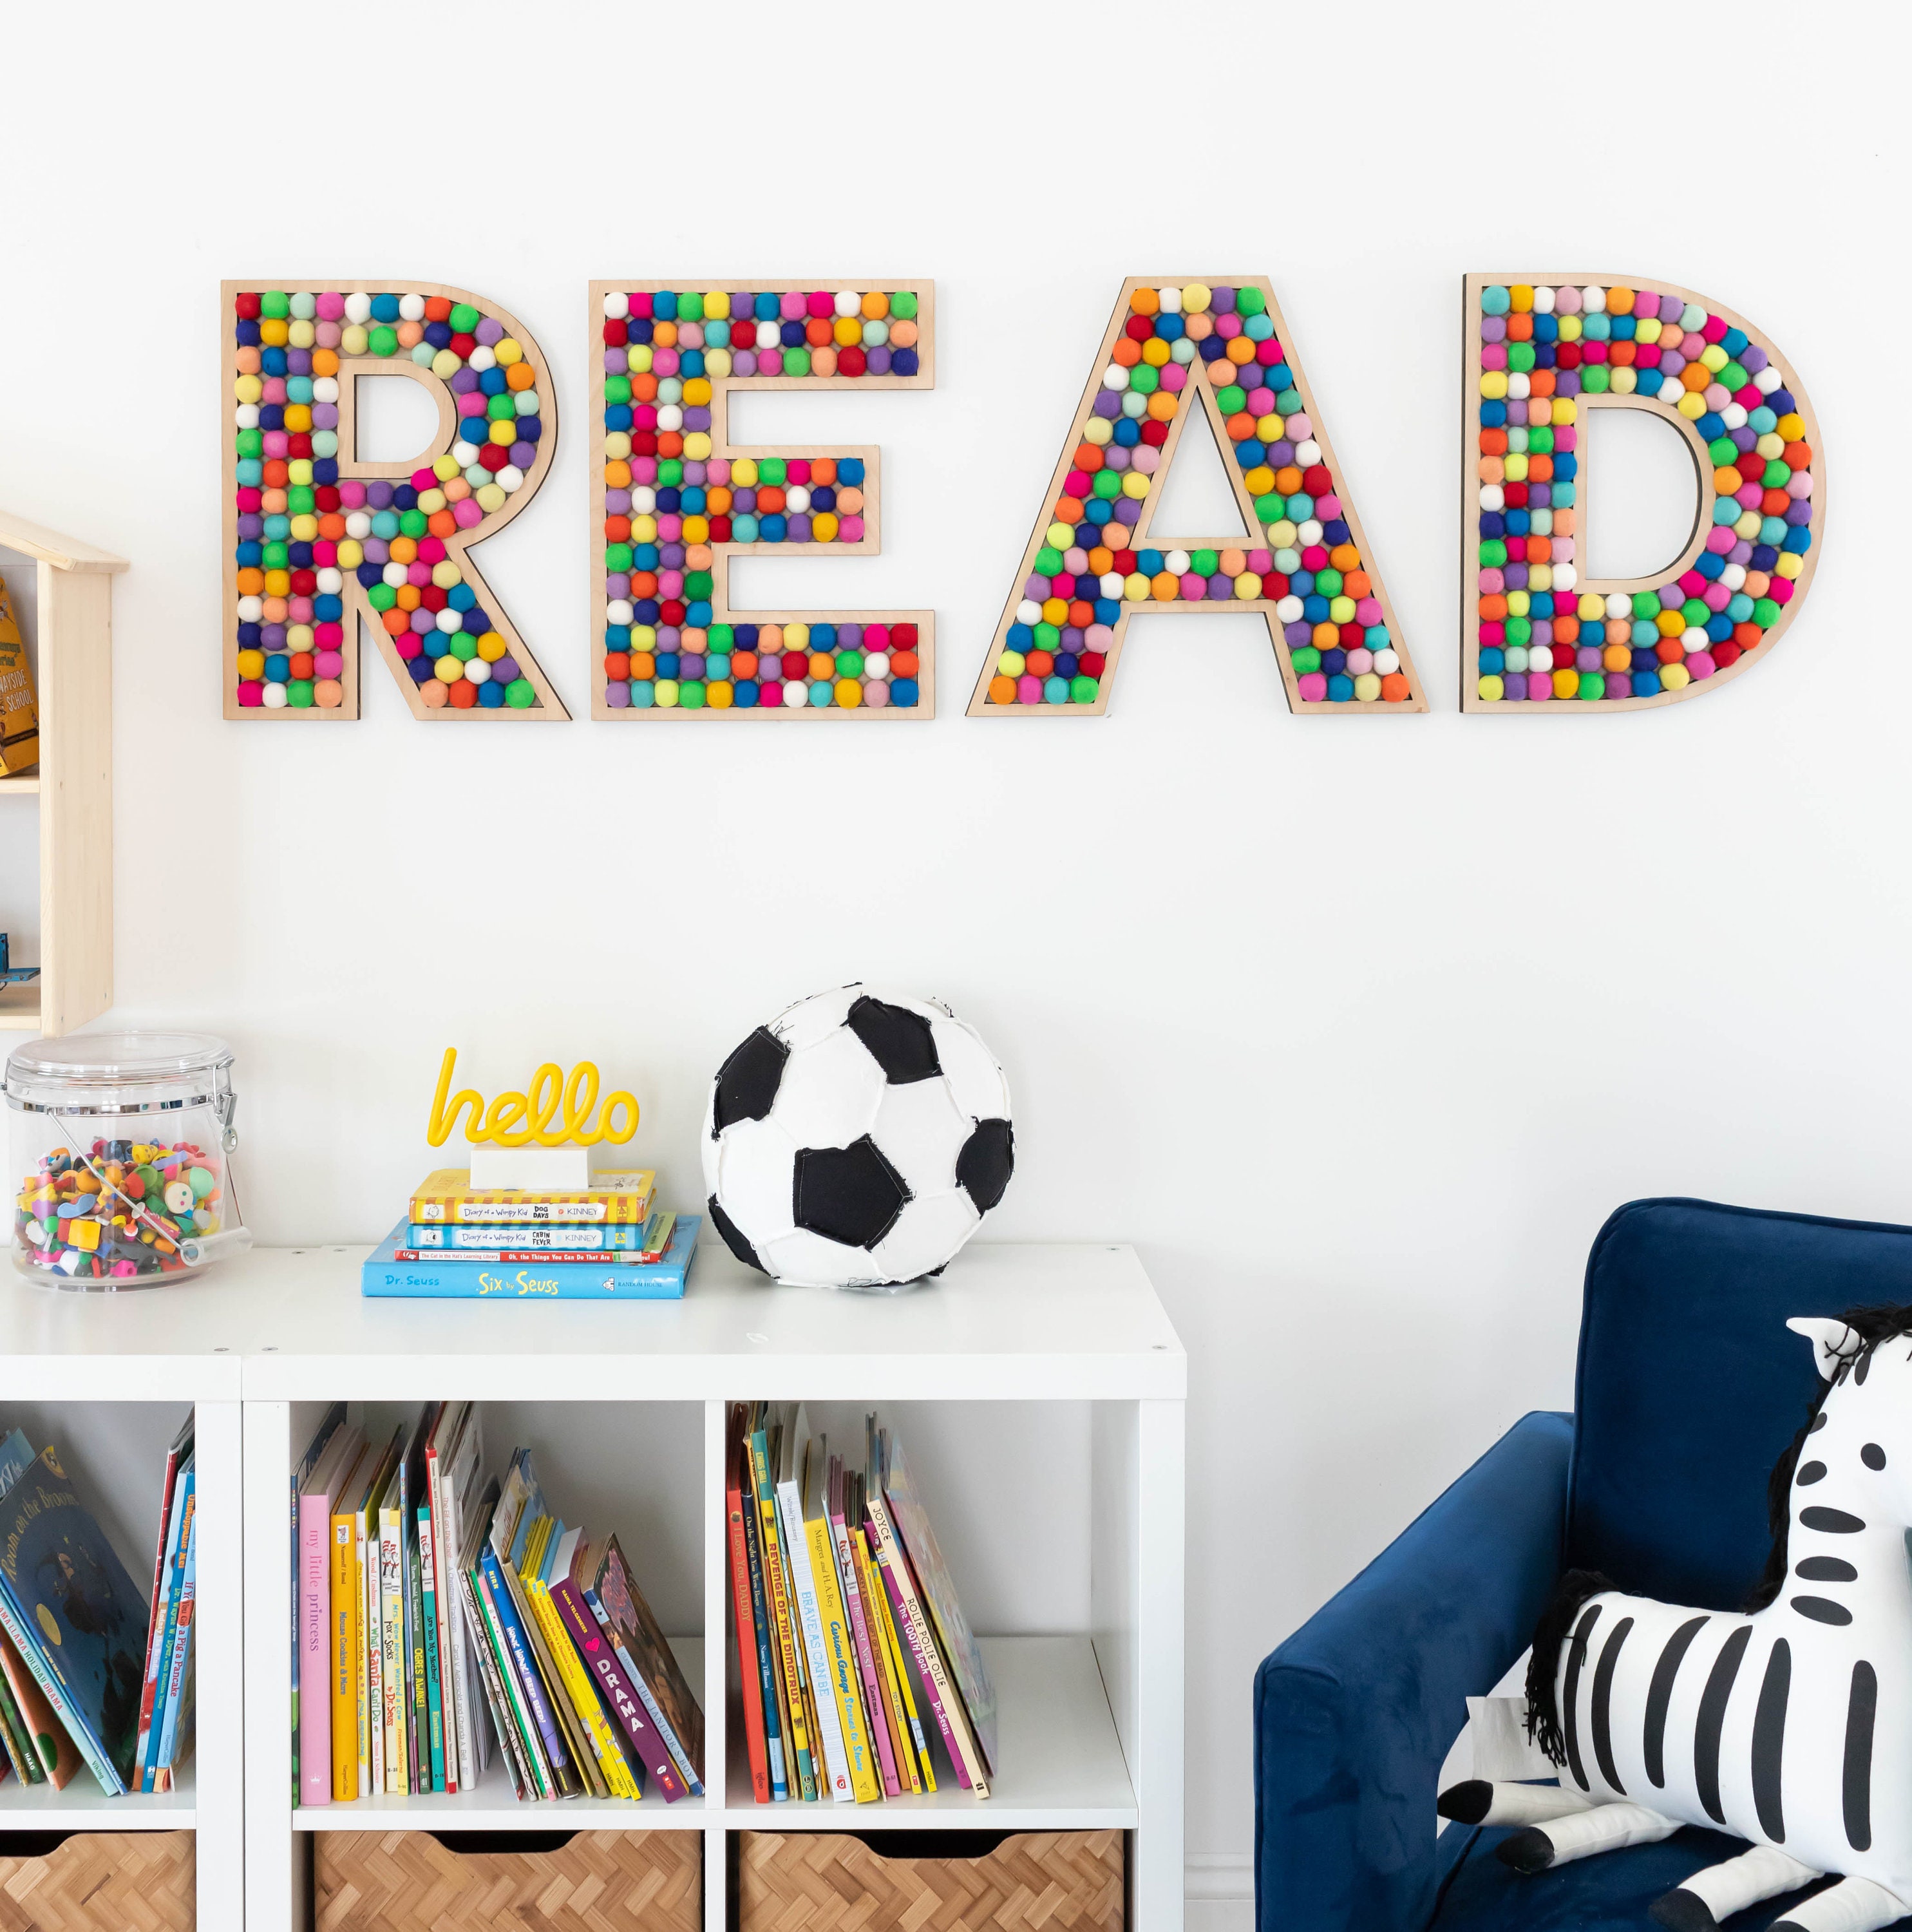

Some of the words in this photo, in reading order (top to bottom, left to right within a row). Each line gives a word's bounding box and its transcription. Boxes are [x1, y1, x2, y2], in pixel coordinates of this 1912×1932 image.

[221, 273, 1826, 721] READ
[6, 689, 33, 712] SCHOOL
[428, 1047, 639, 1147] hello
[464, 1208, 483, 1217] Diary
[495, 1208, 516, 1217] Wimpy
[518, 1208, 528, 1216] Kid
[493, 1234, 515, 1243] Wimpy
[385, 1275, 402, 1284] Dr.
[406, 1276, 439, 1285] Seuss
[479, 1273, 502, 1294] Six
[516, 1271, 558, 1295] Seuss
[755, 1452, 766, 1470] CHRIS
[746, 1516, 753, 1527] On
[871, 1506, 893, 1542] JOYCE
[2, 1533, 20, 1582] Room
[23, 1497, 41, 1519] the
[35, 1486, 79, 1509] Broom
[306, 1530, 318, 1548] my
[733, 1533, 745, 1557] Love
[813, 1530, 826, 1559] Margret
[747, 1540, 756, 1558] Night
[309, 1555, 321, 1587] little
[487, 1569, 500, 1589] KIRK
[734, 1559, 747, 1582] You,
[768, 1542, 784, 1597] REVENGE
[560, 1589, 573, 1605] RAINA
[568, 1604, 589, 1634] TELGEMEIER
[737, 1584, 752, 1622] DADDY
[777, 1600, 786, 1616] OF
[800, 1591, 818, 1631] BRAVE
[851, 1600, 862, 1618] The
[896, 1602, 909, 1619] The
[307, 1593, 322, 1651] princess
[384, 1621, 393, 1633] Fox
[779, 1617, 790, 1640] THE
[856, 1566, 866, 1589] MICKEY
[862, 1596, 873, 1623] MINNIE'S
[871, 1639, 878, 1648] OF
[876, 1662, 884, 1678] MAGI
[856, 1620, 867, 1642] Best
[175, 1636, 186, 1652] Pig
[370, 1627, 379, 1648] What
[427, 1642, 436, 1654] My
[808, 1633, 820, 1649] AS
[829, 1620, 846, 1659] Curious
[901, 1619, 922, 1653] TOOTH
[905, 1597, 924, 1628] ROLIE
[918, 1630, 936, 1660] POLIE
[930, 1662, 947, 1687] OLIE
[339, 1637, 347, 1666] Cookies
[384, 1639, 394, 1660] Socks
[413, 1647, 424, 1674] OGRES
[860, 1645, 872, 1669] Nest
[7, 1624, 28, 1652] LLAMA
[23, 1650, 46, 1683] HOLIDAY
[42, 1681, 63, 1712] DRAMA
[370, 1649, 381, 1686] Santa
[428, 1654, 439, 1683] Mother?
[506, 1625, 522, 1649] HONK
[514, 1648, 531, 1676] HONK!
[524, 1676, 538, 1699] BEEP
[531, 1699, 546, 1723] BEEP!
[783, 1643, 799, 1705] DINOTRUX
[811, 1651, 827, 1680] CAN
[914, 1651, 931, 1676] Book
[169, 1660, 182, 1697] Pancake
[393, 1667, 402, 1696] Wanted
[762, 1665, 770, 1689] Tillman
[817, 1681, 830, 1697] BE
[835, 1659, 852, 1695] George
[371, 1687, 380, 1707] Can't
[385, 1693, 395, 1705] Dr.
[414, 1677, 426, 1707] AWAKE!
[594, 1657, 645, 1732] DRAMA
[868, 1683, 880, 1716] Eastman
[372, 1709, 381, 1721] Do
[386, 1706, 395, 1726] Seuss
[844, 1696, 858, 1730] Stories
[894, 1705, 903, 1722] STORY
[931, 1700, 944, 1714] Dr.
[431, 1710, 442, 1748] Eastman
[637, 1683, 652, 1704] THE
[679, 1758, 694, 1778] BOY
[936, 1712, 953, 1736] Seuss
[850, 1732, 859, 1741] to
[24, 1752, 35, 1770] HAAG
[89, 1759, 106, 1779] Viking
[852, 1745, 867, 1772] Share
